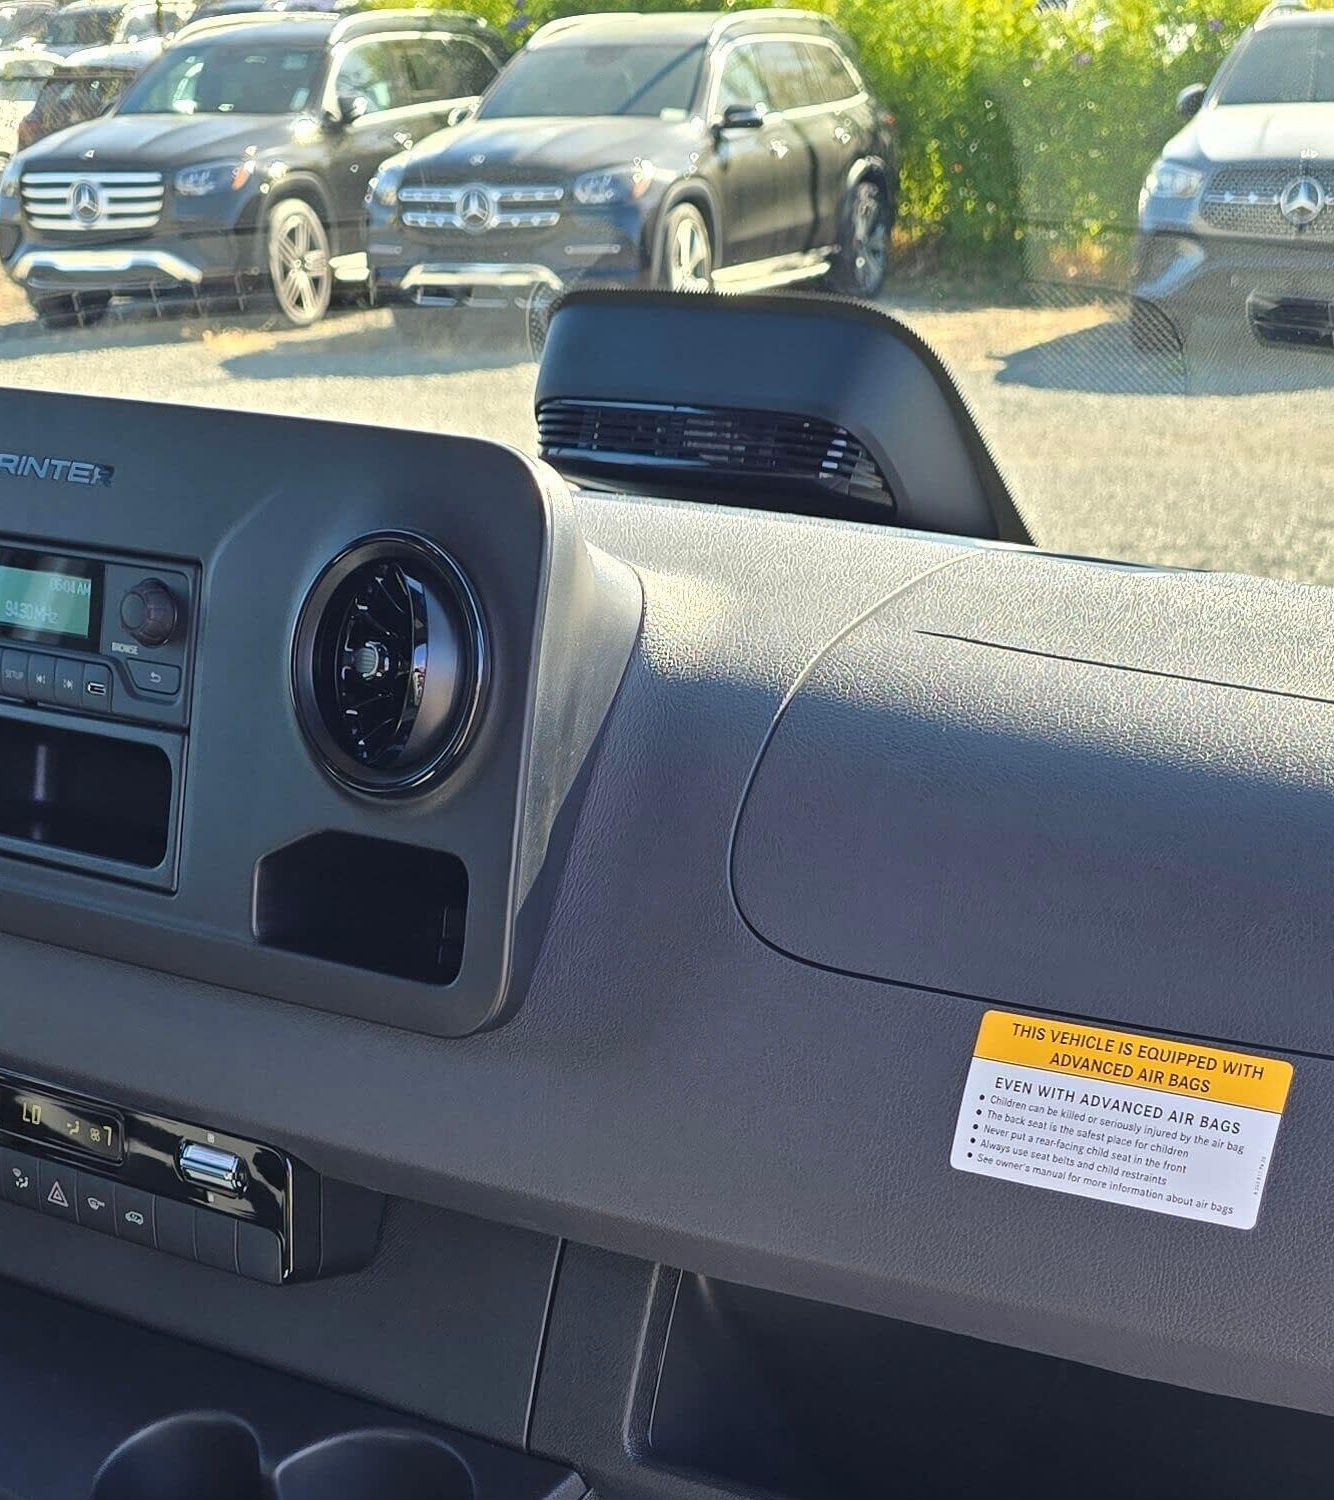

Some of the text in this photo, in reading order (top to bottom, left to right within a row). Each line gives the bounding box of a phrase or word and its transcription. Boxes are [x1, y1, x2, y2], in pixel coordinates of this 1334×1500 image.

[1012, 1023, 1264, 1080] THIS VEHICLE IS EQUIPPED WITH
[1049, 1052, 1211, 1092] ADVANCED AIR BAGS
[990, 1095, 1245, 1155] Children can be killed or seriously injured by the air bag
[995, 1077, 1241, 1134] EVEN WITH ADVANCED AIR BAGS
[984, 1124, 1187, 1174] Never put a rear-facing child seat in the front
[987, 1109, 1189, 1158] The back seat is the safest place for children
[977, 1153, 1234, 1215] See owner's manual for more information about air bags
[980, 1139, 1168, 1186] Always use seat belts and child restraints
